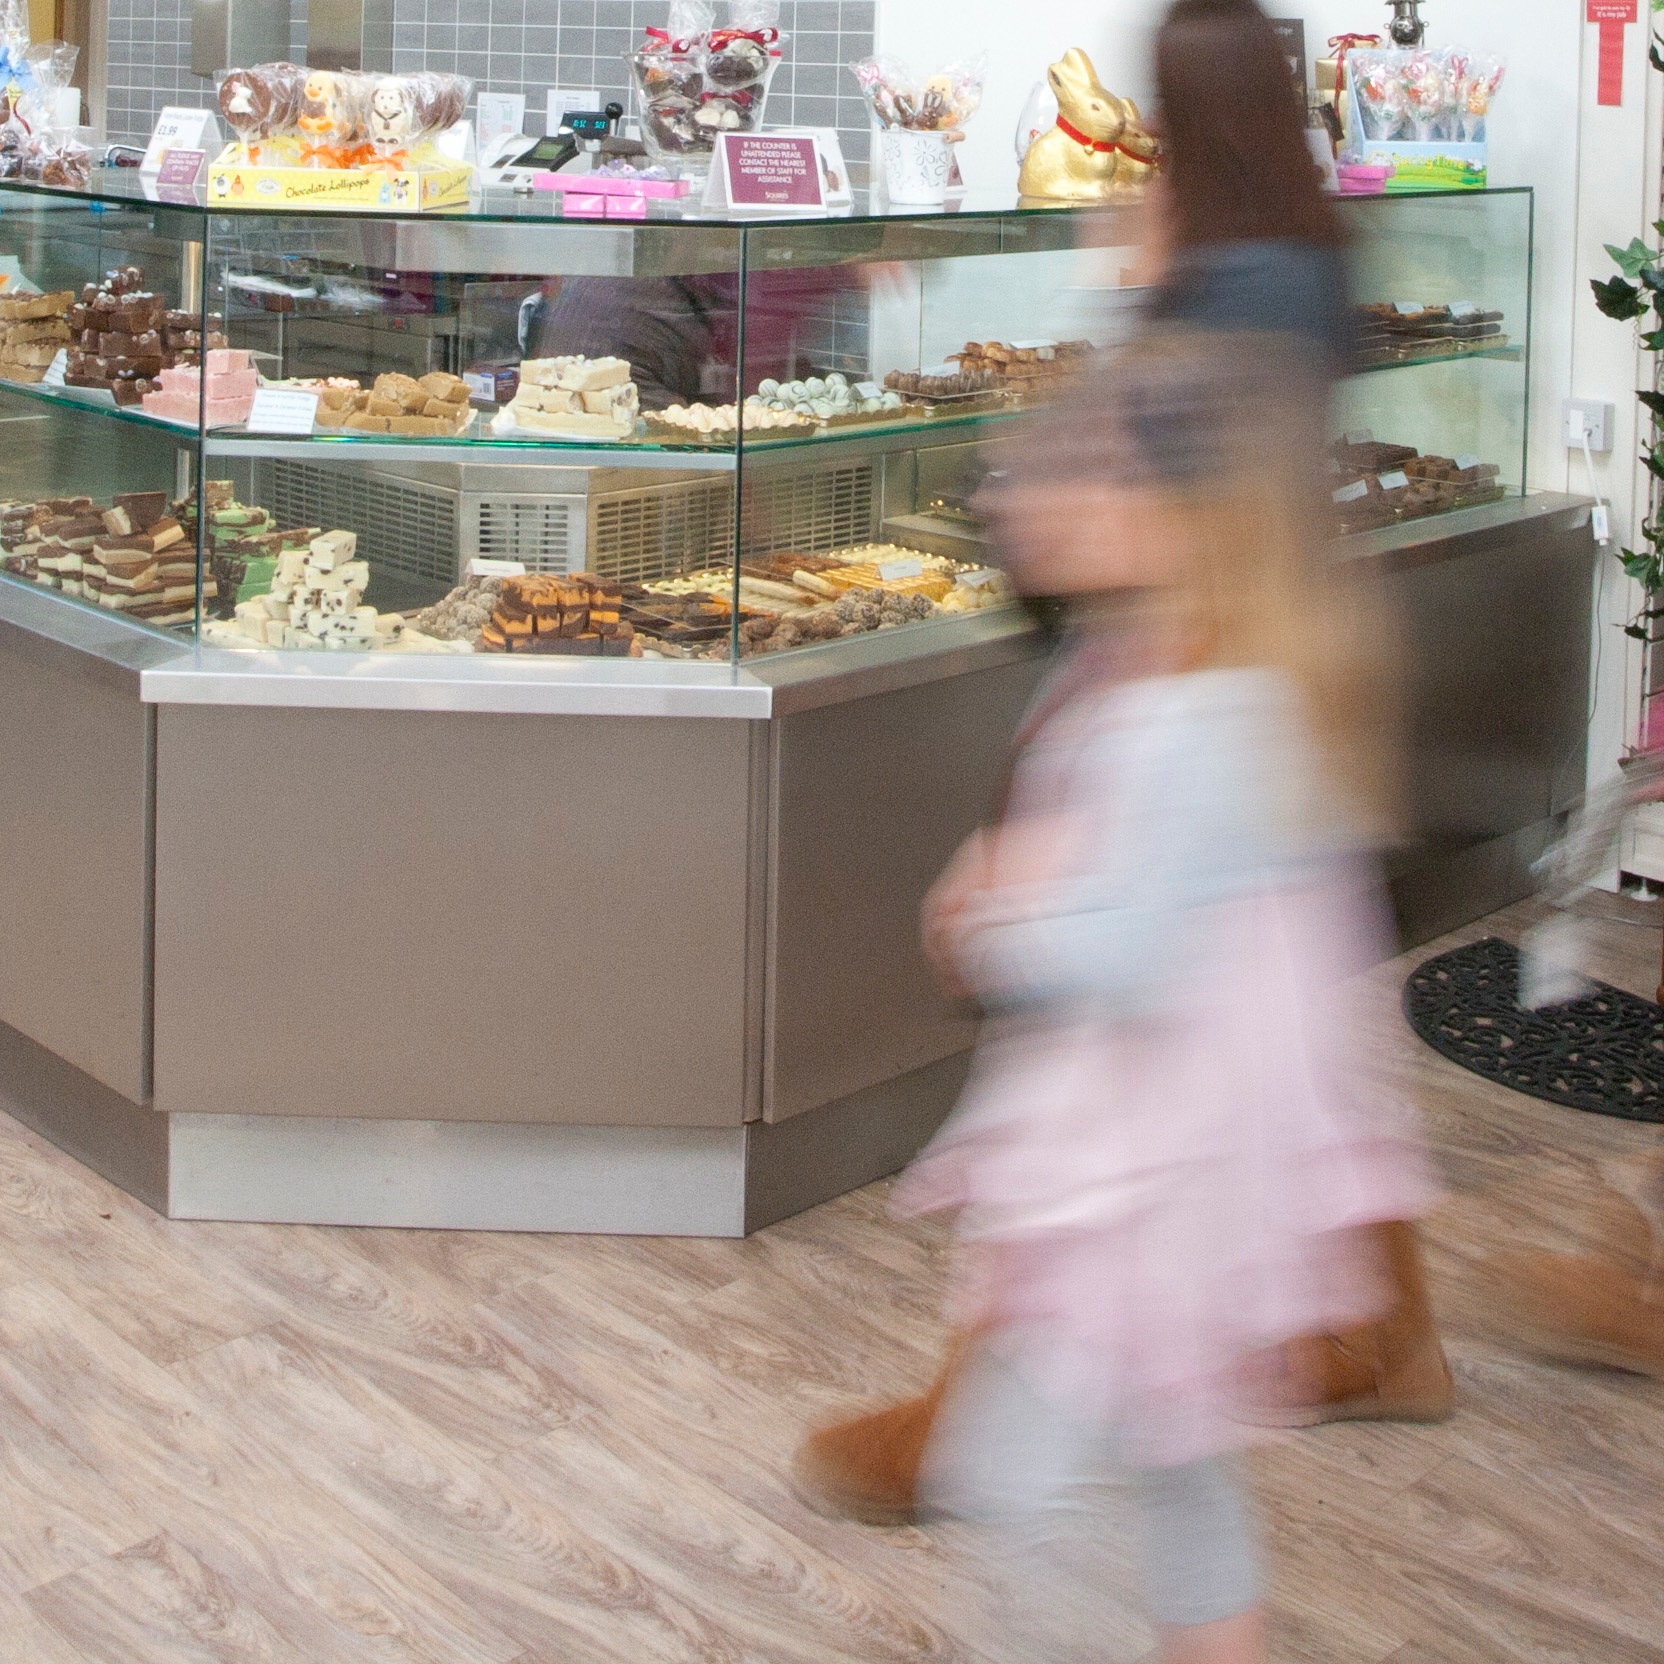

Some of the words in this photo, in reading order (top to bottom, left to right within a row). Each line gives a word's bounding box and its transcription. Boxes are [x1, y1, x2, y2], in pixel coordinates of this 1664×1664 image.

[158, 125, 178, 136] £1.99
[762, 142, 791, 150] COUNTER
[740, 150, 780, 158] UNATTENDED
[781, 151, 801, 159] PLEASE
[739, 158, 767, 166] CONTACT
[780, 159, 806, 167] NEAREST
[741, 167, 766, 175] MEMBER
[767, 167, 776, 175] OF
[777, 167, 793, 175] STAFF
[794, 168, 806, 176] FOR
[757, 176, 793, 184] ASSISTANCE
[285, 183, 326, 198] Chocolate
[329, 177, 370, 192] Lollipops
